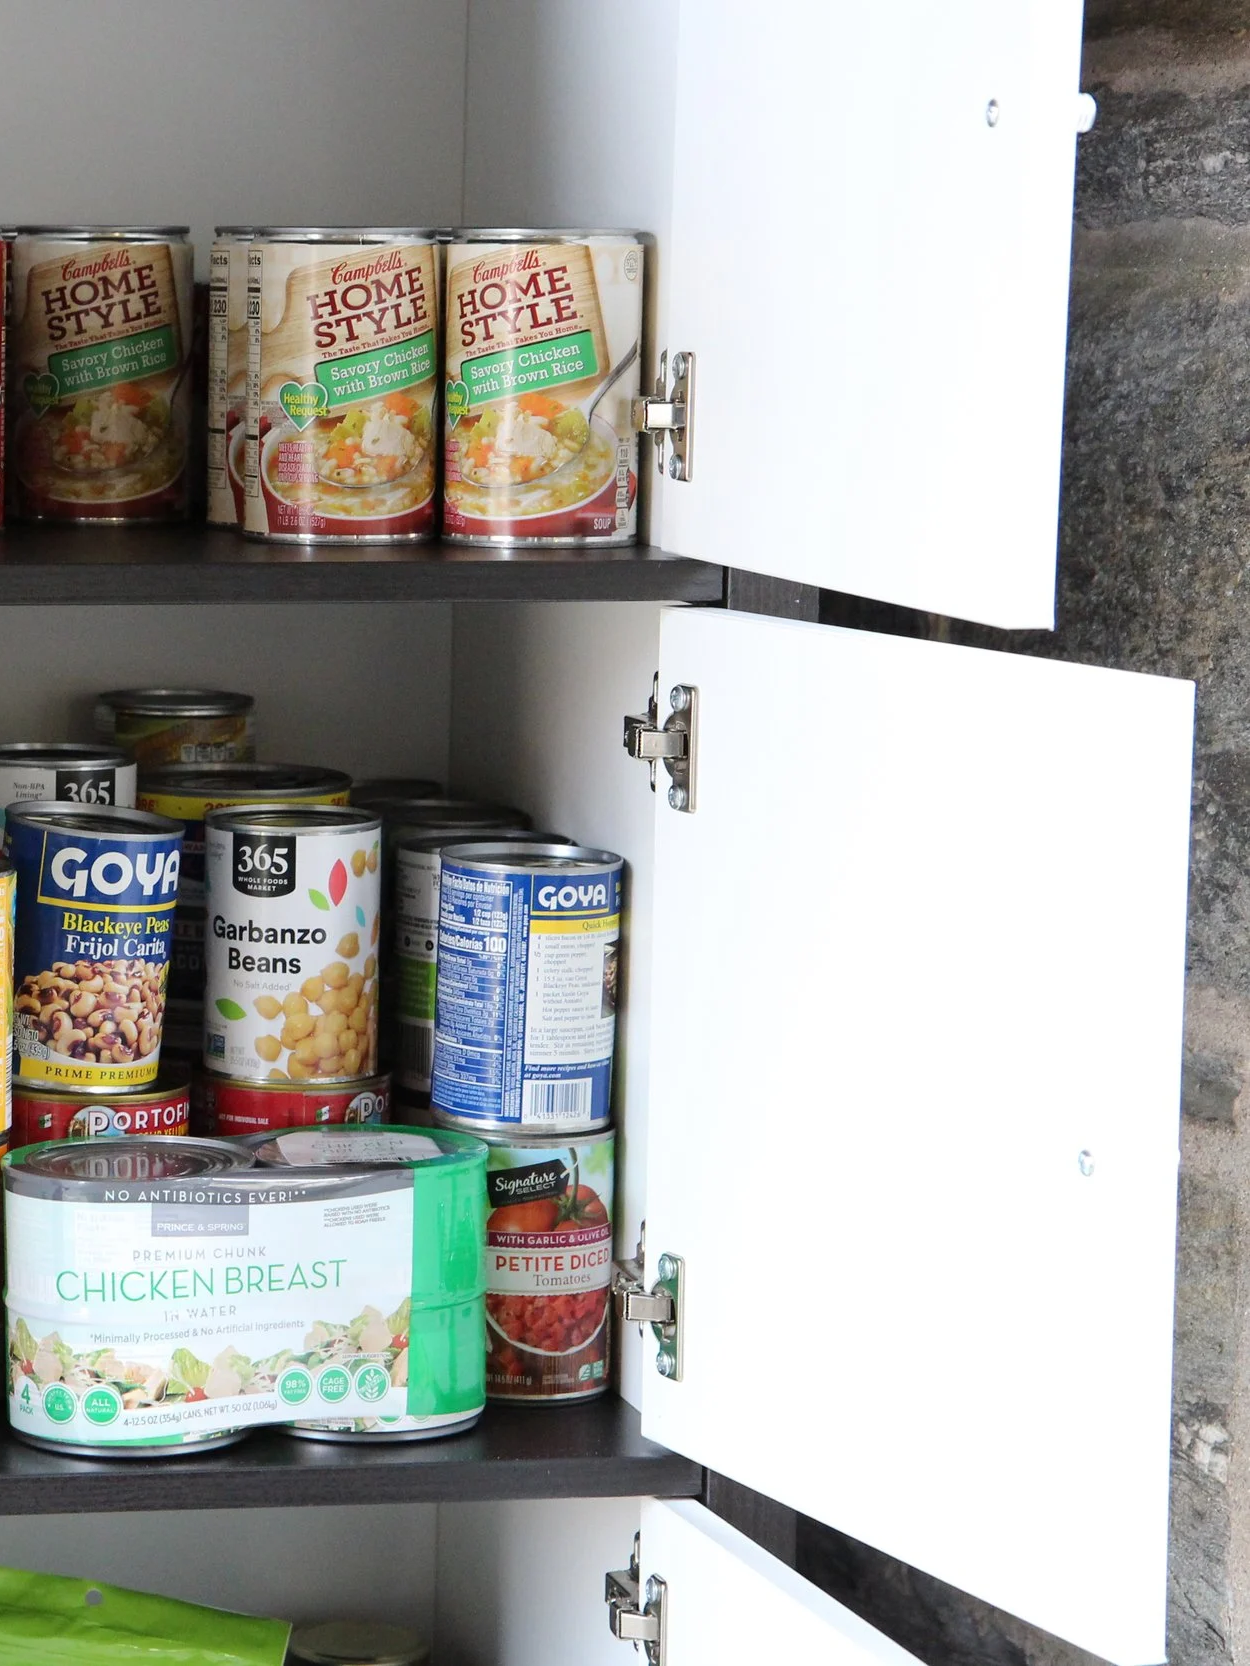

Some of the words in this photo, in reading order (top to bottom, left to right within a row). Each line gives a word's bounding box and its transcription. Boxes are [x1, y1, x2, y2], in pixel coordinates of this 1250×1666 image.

[61, 250, 132, 281] Campbell's
[331, 251, 405, 285] Campbell's
[473, 250, 541, 284] Campbell's
[41, 264, 156, 315] HOME
[306, 267, 423, 322] HOME
[457, 266, 572, 319] HOME
[47, 291, 162, 341] STYLE
[314, 294, 428, 349] STYLE
[461, 294, 578, 347] STYLE
[331, 361, 380, 382] Savory
[384, 342, 428, 366] Chicken
[471, 363, 515, 380] Savory
[518, 344, 580, 367] Chicken
[333, 379, 366, 397] with
[368, 370, 409, 389] Brown
[411, 360, 430, 376] Rice
[472, 378, 500, 395] with
[503, 365, 549, 387] Brown
[552, 360, 584, 376] Rice
[283, 393, 319, 405] Healthy
[289, 405, 329, 417] Request
[594, 518, 611, 530] SOUP
[64, 778, 112, 805] 365
[51, 847, 180, 897] GOYA
[238, 844, 289, 875] 365
[538, 884, 606, 911] GOYA
[62, 912, 142, 939] Blackeye
[145, 916, 170, 935] Peas
[213, 915, 327, 945] Garbanzo
[65, 934, 119, 960] Frijol
[484, 936, 507, 953] 100
[228, 947, 301, 974] Beans
[45, 1065, 92, 1079] PRIME
[100, 1065, 152, 1080] PREMIUM
[495, 1172, 557, 1195] Signature
[515, 1181, 556, 1194] SELECT
[105, 1191, 130, 1201] NO
[138, 1191, 241, 1203] ANTIBIOTICS
[157, 1223, 194, 1232] PRINCE
[197, 1224, 205, 1232] &
[207, 1223, 244, 1232] SPRING
[497, 1235, 525, 1245] WITH
[528, 1235, 566, 1245] GARLIC
[569, 1234, 575, 1242] &
[577, 1232, 600, 1242] OLIVE
[601, 1229, 610, 1238] OIL
[133, 1249, 206, 1261] PREMIUM
[213, 1247, 266, 1259] CHUNK
[496, 1255, 565, 1272] PETITE
[570, 1248, 610, 1270] DICED
[56, 1268, 214, 1302] CHICKEN
[225, 1259, 347, 1295] BREAST
[533, 1273, 591, 1287] Tomatoes
[186, 1306, 237, 1319] WATER
[21, 1383, 31, 1404] 4
[285, 1380, 306, 1389] 98%
[322, 1377, 345, 1385] CAGE
[322, 1385, 345, 1393] FREE
[19, 1405, 33, 1415] PACK
[86, 1406, 115, 1414] NATURAL
[91, 1399, 110, 1407] ALL
